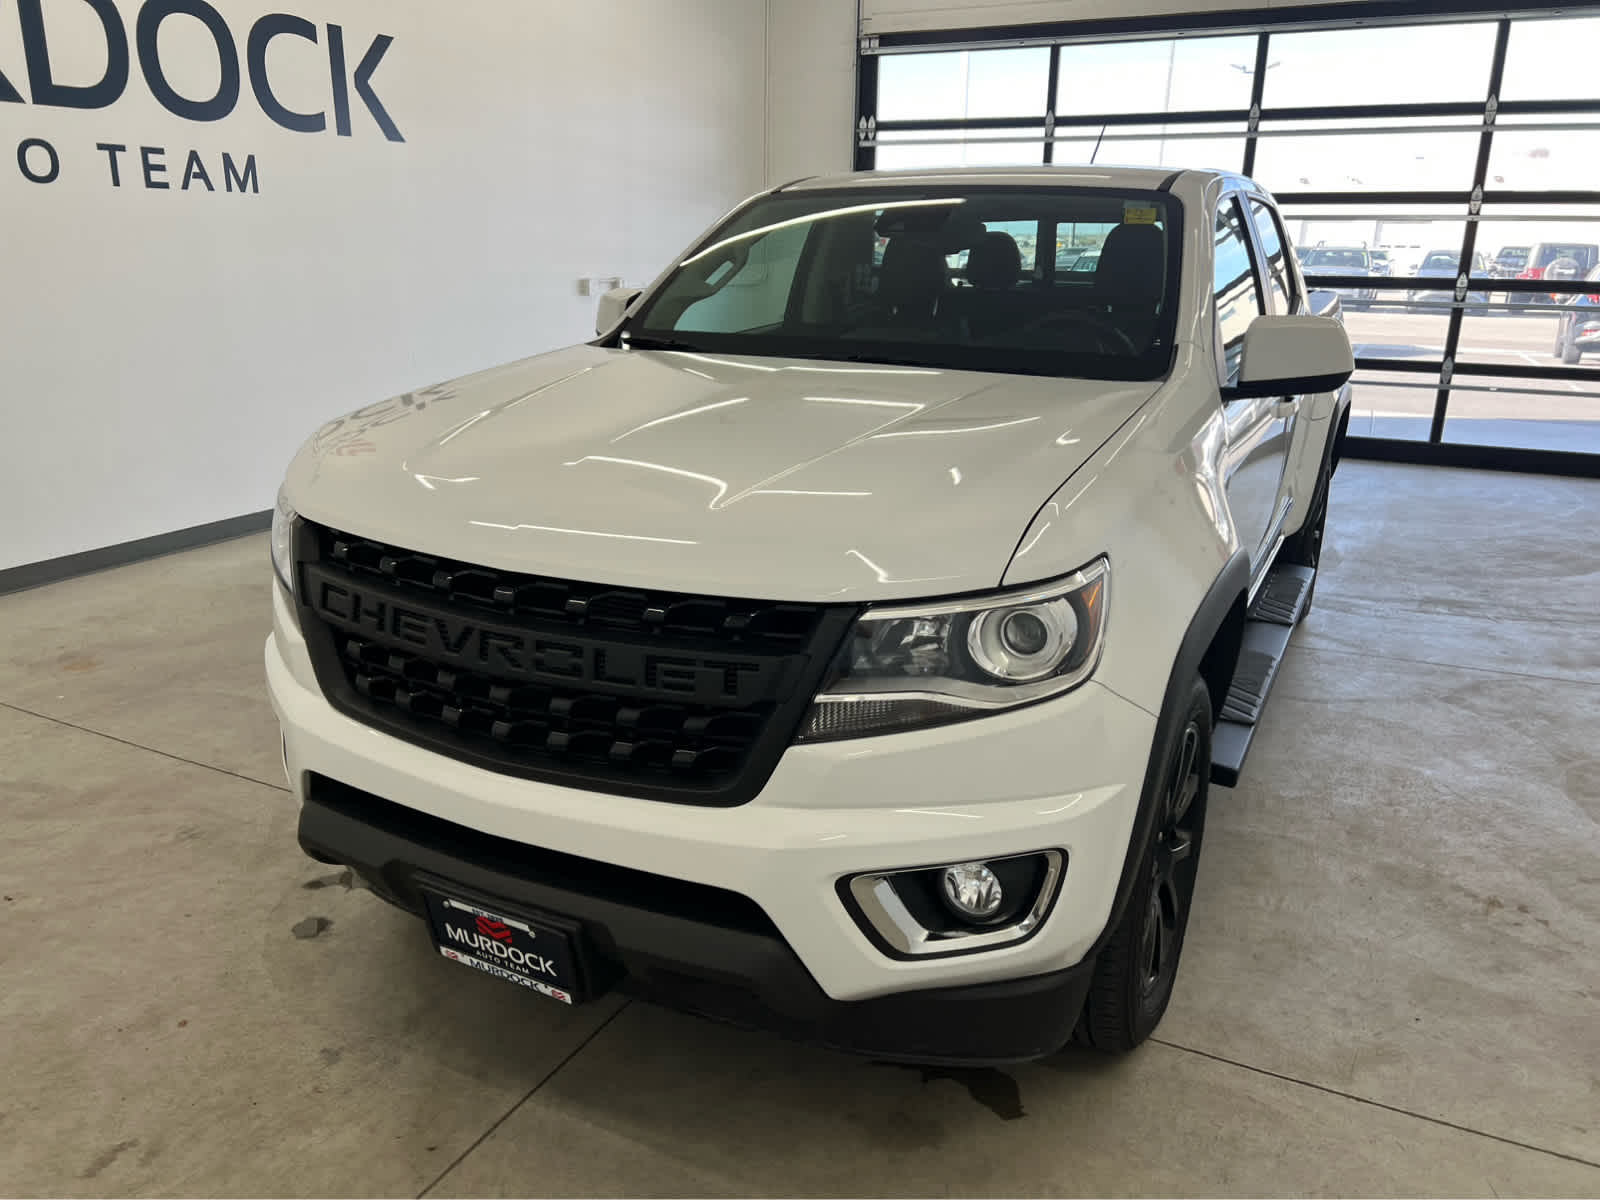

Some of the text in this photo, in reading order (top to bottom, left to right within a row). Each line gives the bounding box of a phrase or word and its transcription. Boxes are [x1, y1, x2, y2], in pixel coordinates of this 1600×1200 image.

[0, 0, 406, 143] DOCK
[96, 142, 260, 194] TEAM
[318, 580, 760, 697] CHEVROLET
[445, 922, 558, 977] MURDOCK
[468, 957, 541, 993] MURDOCK
[476, 949, 530, 975] AUTO TEAM
